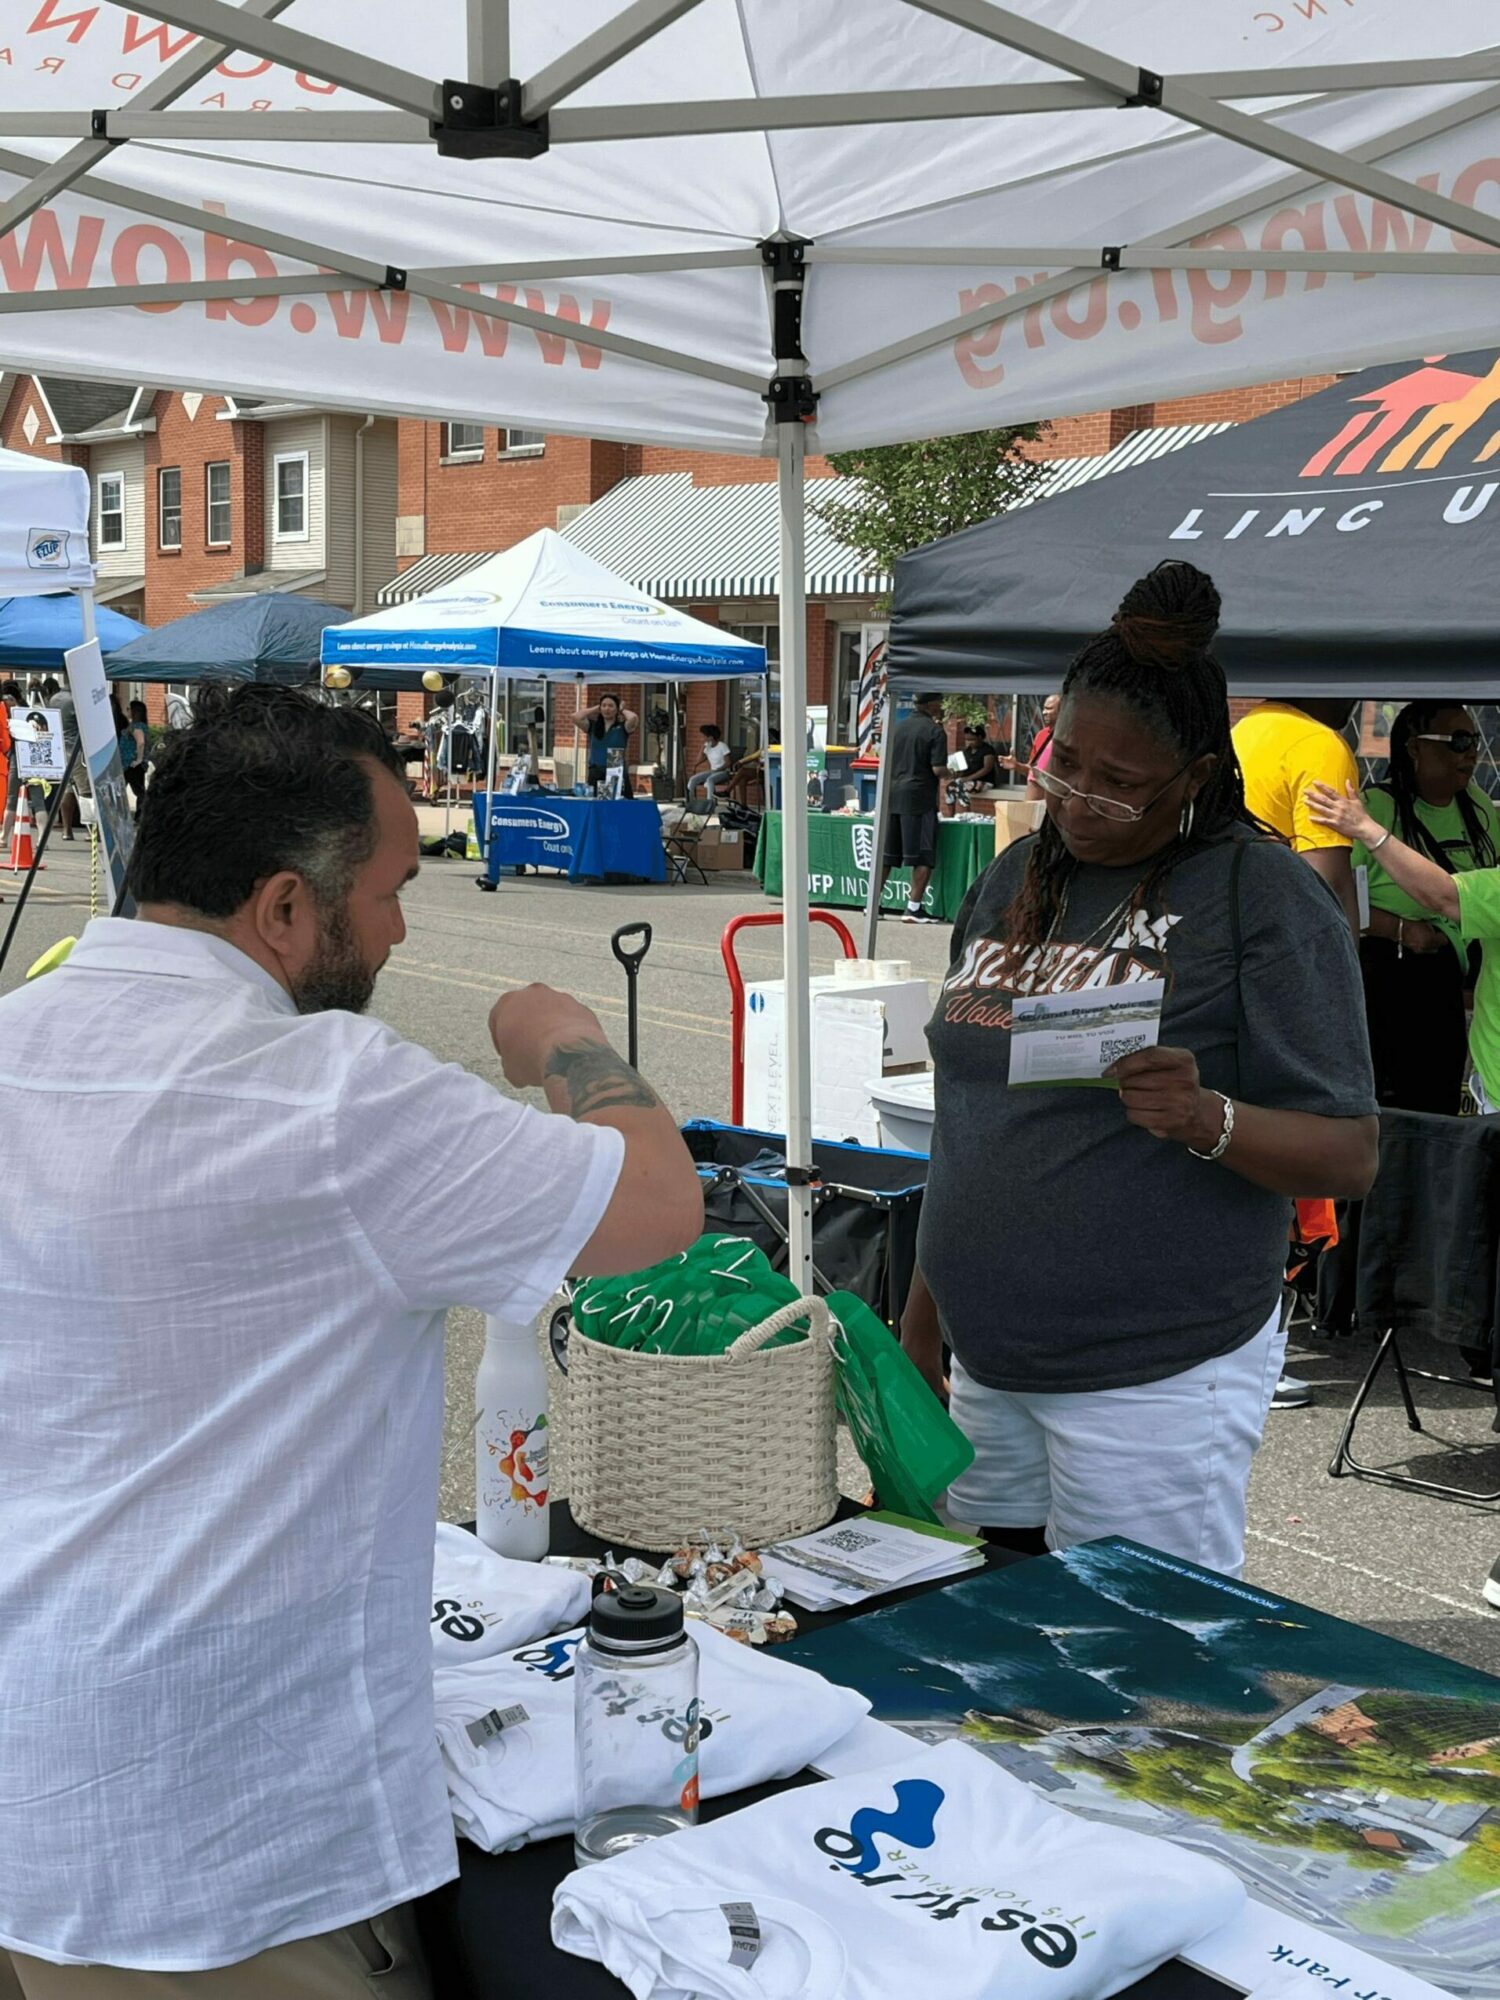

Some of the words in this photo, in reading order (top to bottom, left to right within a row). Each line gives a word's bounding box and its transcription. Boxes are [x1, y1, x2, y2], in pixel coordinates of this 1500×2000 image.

[1168, 500, 1384, 540] LINC
[540, 600, 608, 609] Consumers
[609, 602, 650, 612] Energy
[529, 644, 554, 653] Learn
[555, 646, 580, 655] about
[581, 648, 609, 659] energy
[610, 649, 639, 660] savings
[491, 815, 538, 828] Consumers
[538, 818, 563, 833] Energy
[841, 876, 934, 906] INDSTRS
[1184, 1571, 1225, 1589] FUTURE
[887, 1849, 953, 1893] RIVER
[891, 1891, 981, 1921] tu
[1041, 1906, 1097, 1939] IT'S
[981, 1908, 1077, 1968] es
